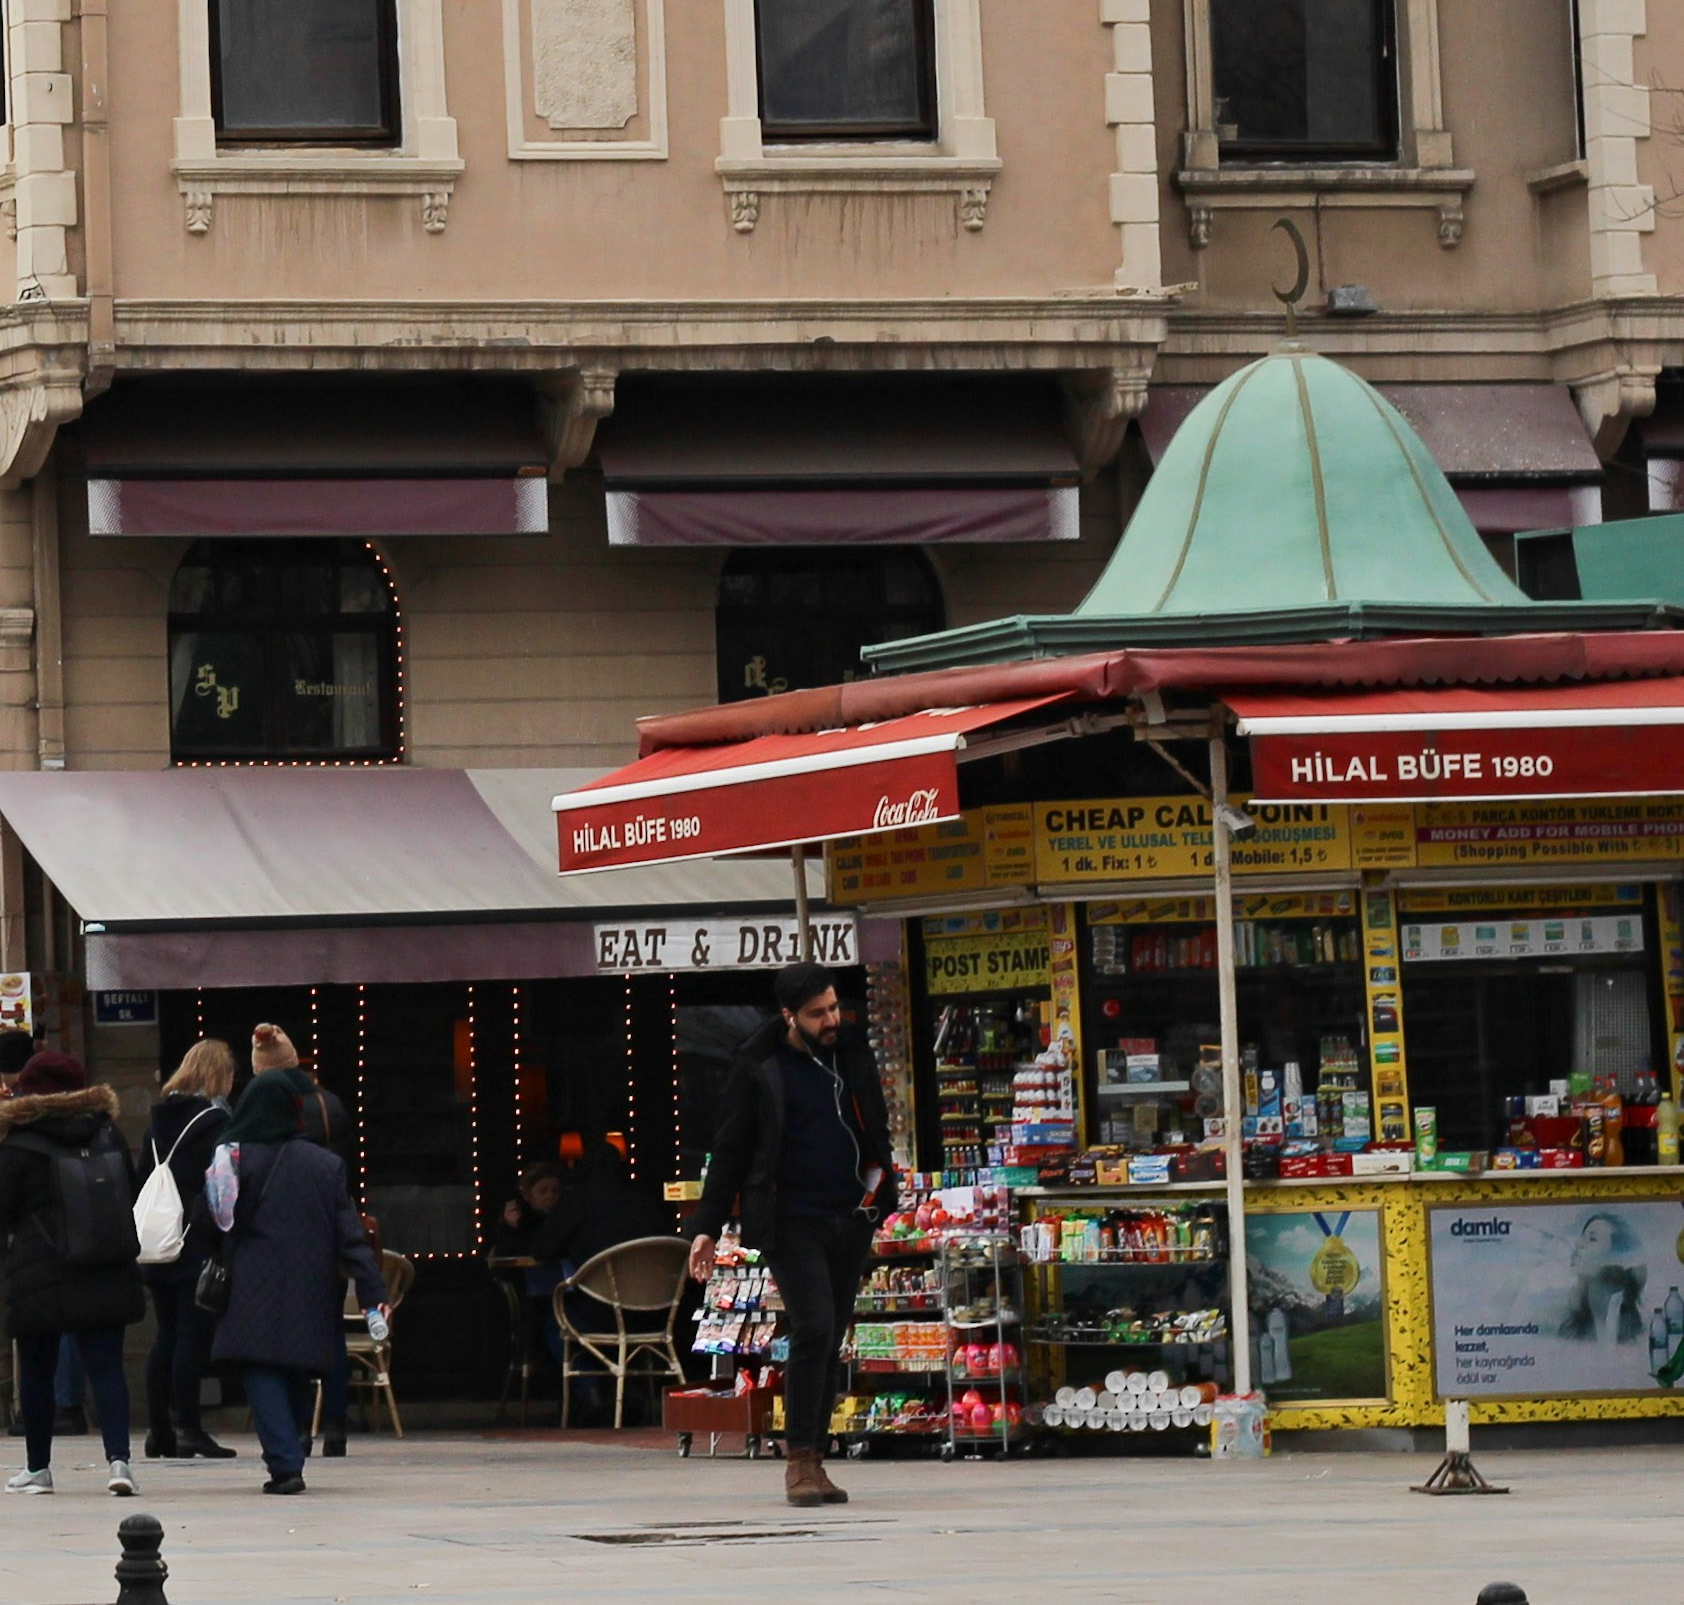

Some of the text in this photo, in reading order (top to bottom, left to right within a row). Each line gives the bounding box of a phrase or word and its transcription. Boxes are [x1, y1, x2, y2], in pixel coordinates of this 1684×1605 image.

[1290, 748, 1554, 783] HİLAL BÜFE 1980
[1045, 806, 1145, 832] CHEAP
[1155, 805, 1214, 827] CAL
[573, 814, 700, 855] HİLAL BÜFE 1980
[1048, 836, 1093, 852] YEREL
[1097, 835, 1117, 850] VE
[1121, 833, 1177, 849] ULUSAL
[1431, 827, 1490, 841] MONEY
[1496, 826, 1531, 840] ADD
[1535, 825, 1569, 839] FOR
[1574, 824, 1638, 837] MOBILE
[1062, 858, 1070, 871] 1
[1075, 856, 1098, 871] dk.
[1102, 855, 1130, 870] Fix:
[1134, 855, 1141, 869] 1
[1190, 853, 1198, 866] 1
[1289, 848, 1313, 864] 1,5
[1453, 844, 1527, 861] (Shopping
[1533, 840, 1594, 855] Possible
[1598, 839, 1629, 853] With
[597, 928, 666, 969] EAT
[691, 928, 711, 967] &
[933, 952, 981, 978] POST
[1450, 1217, 1512, 1237] damla
[1454, 1323, 1539, 1336] Her damlasında
[1456, 1357, 1472, 1368] her
